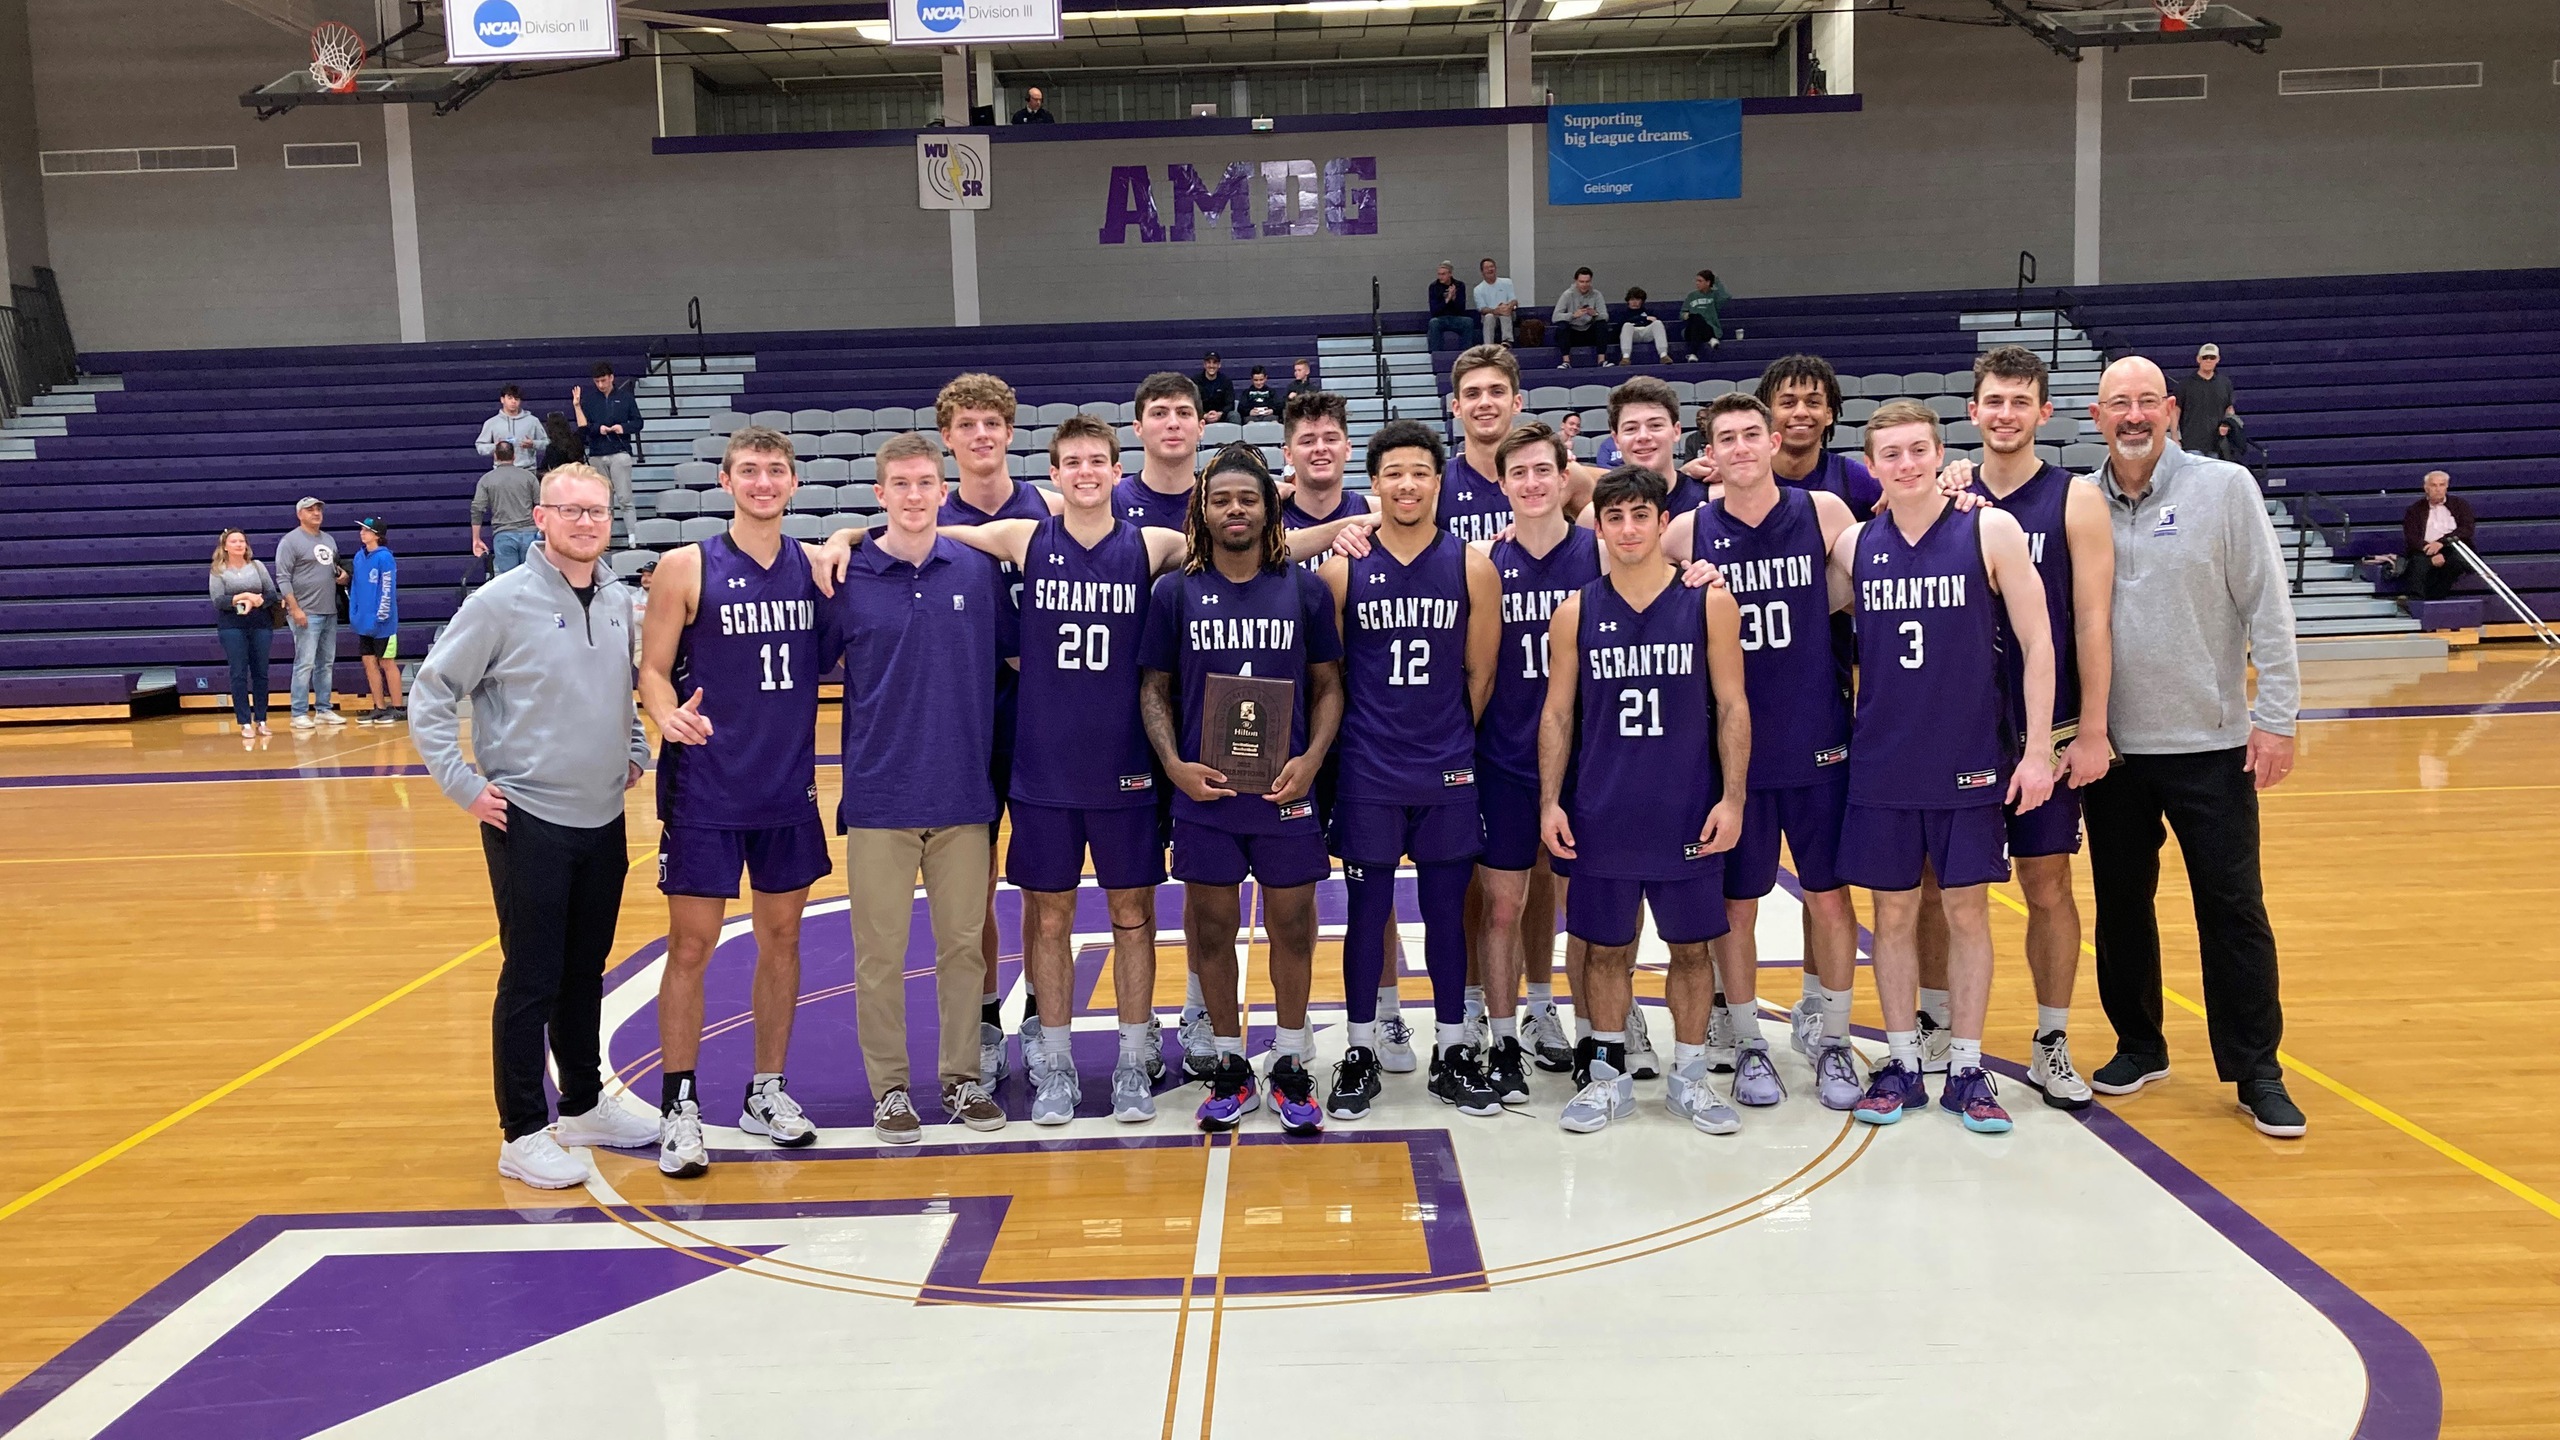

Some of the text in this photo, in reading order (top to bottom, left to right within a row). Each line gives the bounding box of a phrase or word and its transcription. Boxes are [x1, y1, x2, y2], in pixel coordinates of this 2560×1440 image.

[479, 18, 589, 36] NCAA Division III
[922, 4, 1033, 21] NCAA Division III
[1564, 112, 1643, 130] Supporting
[1564, 129, 1693, 148] big league dreams.
[924, 143, 948, 158] WU
[962, 180, 984, 197] SR
[1099, 156, 1378, 245] AMDG
[1584, 182, 1633, 195] Geisinger
[1449, 511, 1515, 543] SCRAN
[1718, 554, 1812, 594] CRANTON
[1035, 578, 1137, 614] SCRANTON
[1862, 574, 1966, 612] SCRANTON
[720, 600, 815, 635] SCRANTON
[1357, 597, 1459, 630] SCRANTON
[1739, 600, 1792, 651] 30
[1057, 623, 1110, 671] 20
[1189, 618, 1295, 651] SCRANTON
[1898, 620, 1924, 669] 3
[759, 642, 794, 691] 11
[1388, 639, 1431, 685] 12
[1588, 643, 1694, 680] SCRANTON
[1618, 687, 1664, 737] 21
